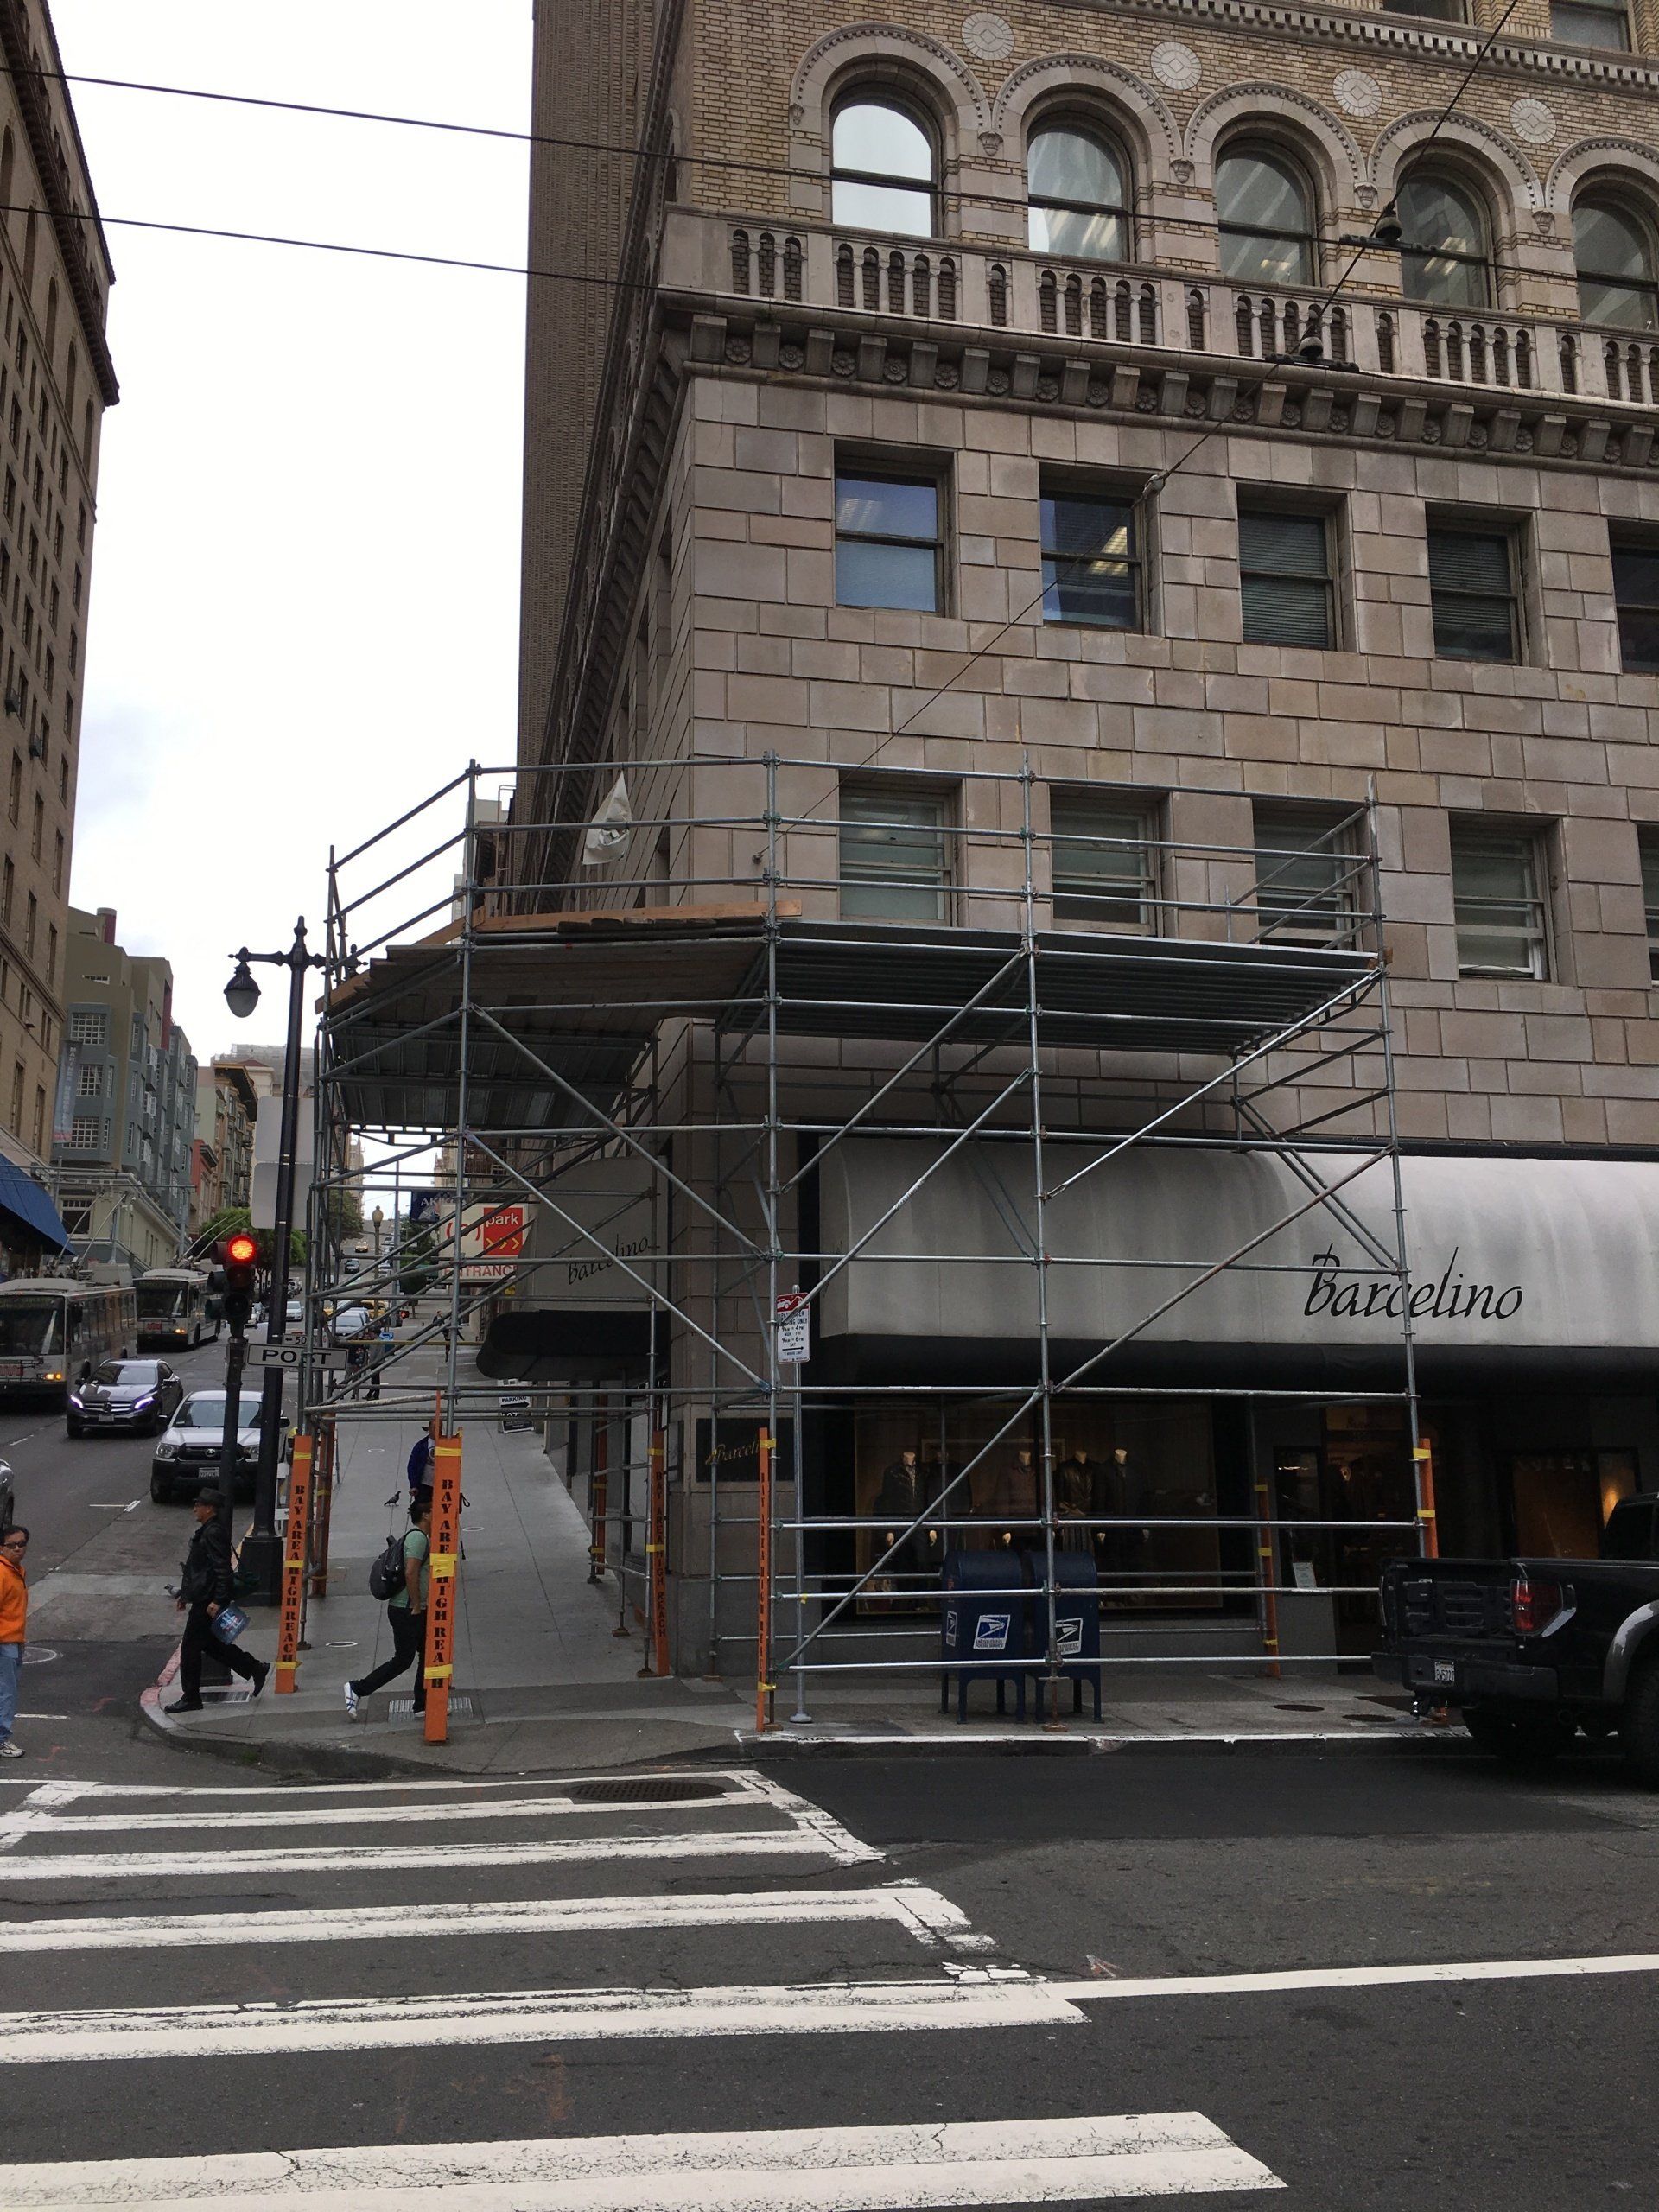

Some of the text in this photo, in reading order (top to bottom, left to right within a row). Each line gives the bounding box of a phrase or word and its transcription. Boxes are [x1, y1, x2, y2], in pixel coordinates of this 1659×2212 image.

[486, 1212, 519, 1228] park
[1304, 1243, 1523, 1319] Barcelino
[283, 1485, 305, 1662] BAY AREA HIGH REACH
[431, 1479, 454, 1688] BAY ARE HIGH REAH
